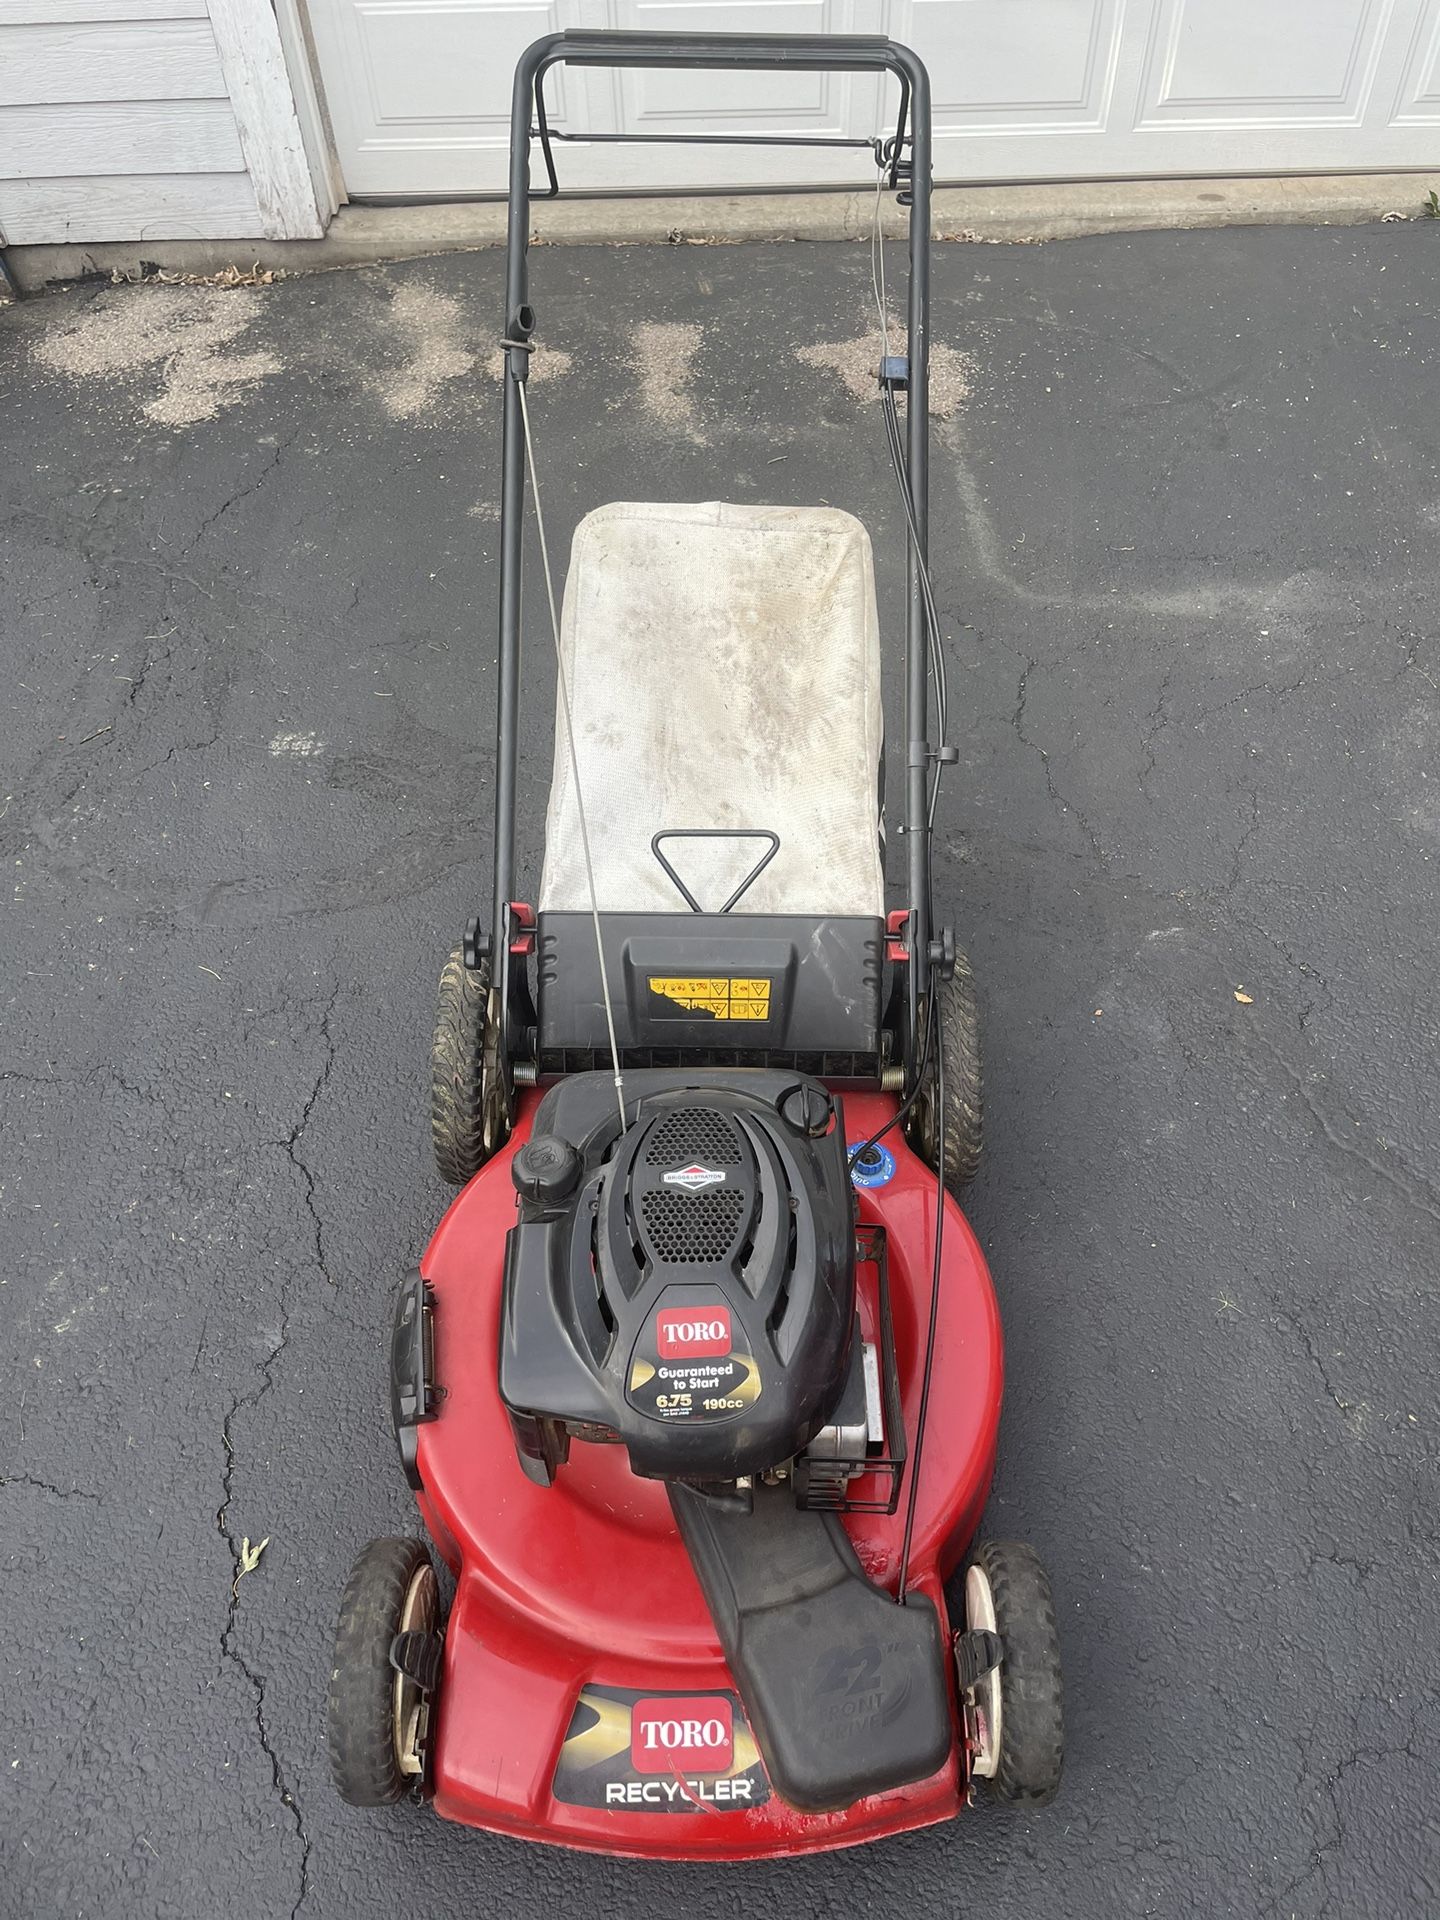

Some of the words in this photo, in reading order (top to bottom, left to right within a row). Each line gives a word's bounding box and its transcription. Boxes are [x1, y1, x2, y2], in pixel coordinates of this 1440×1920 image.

[663, 1321, 727, 1342] TORO
[658, 1363, 733, 1379] Guaranteed
[673, 1379, 687, 1390] to
[689, 1378, 720, 1389] Start
[656, 1394, 692, 1407] 6.75
[703, 1398, 744, 1411] 190cc
[640, 1719, 726, 1749] TORO
[606, 1779, 752, 1804] RECYCLER
